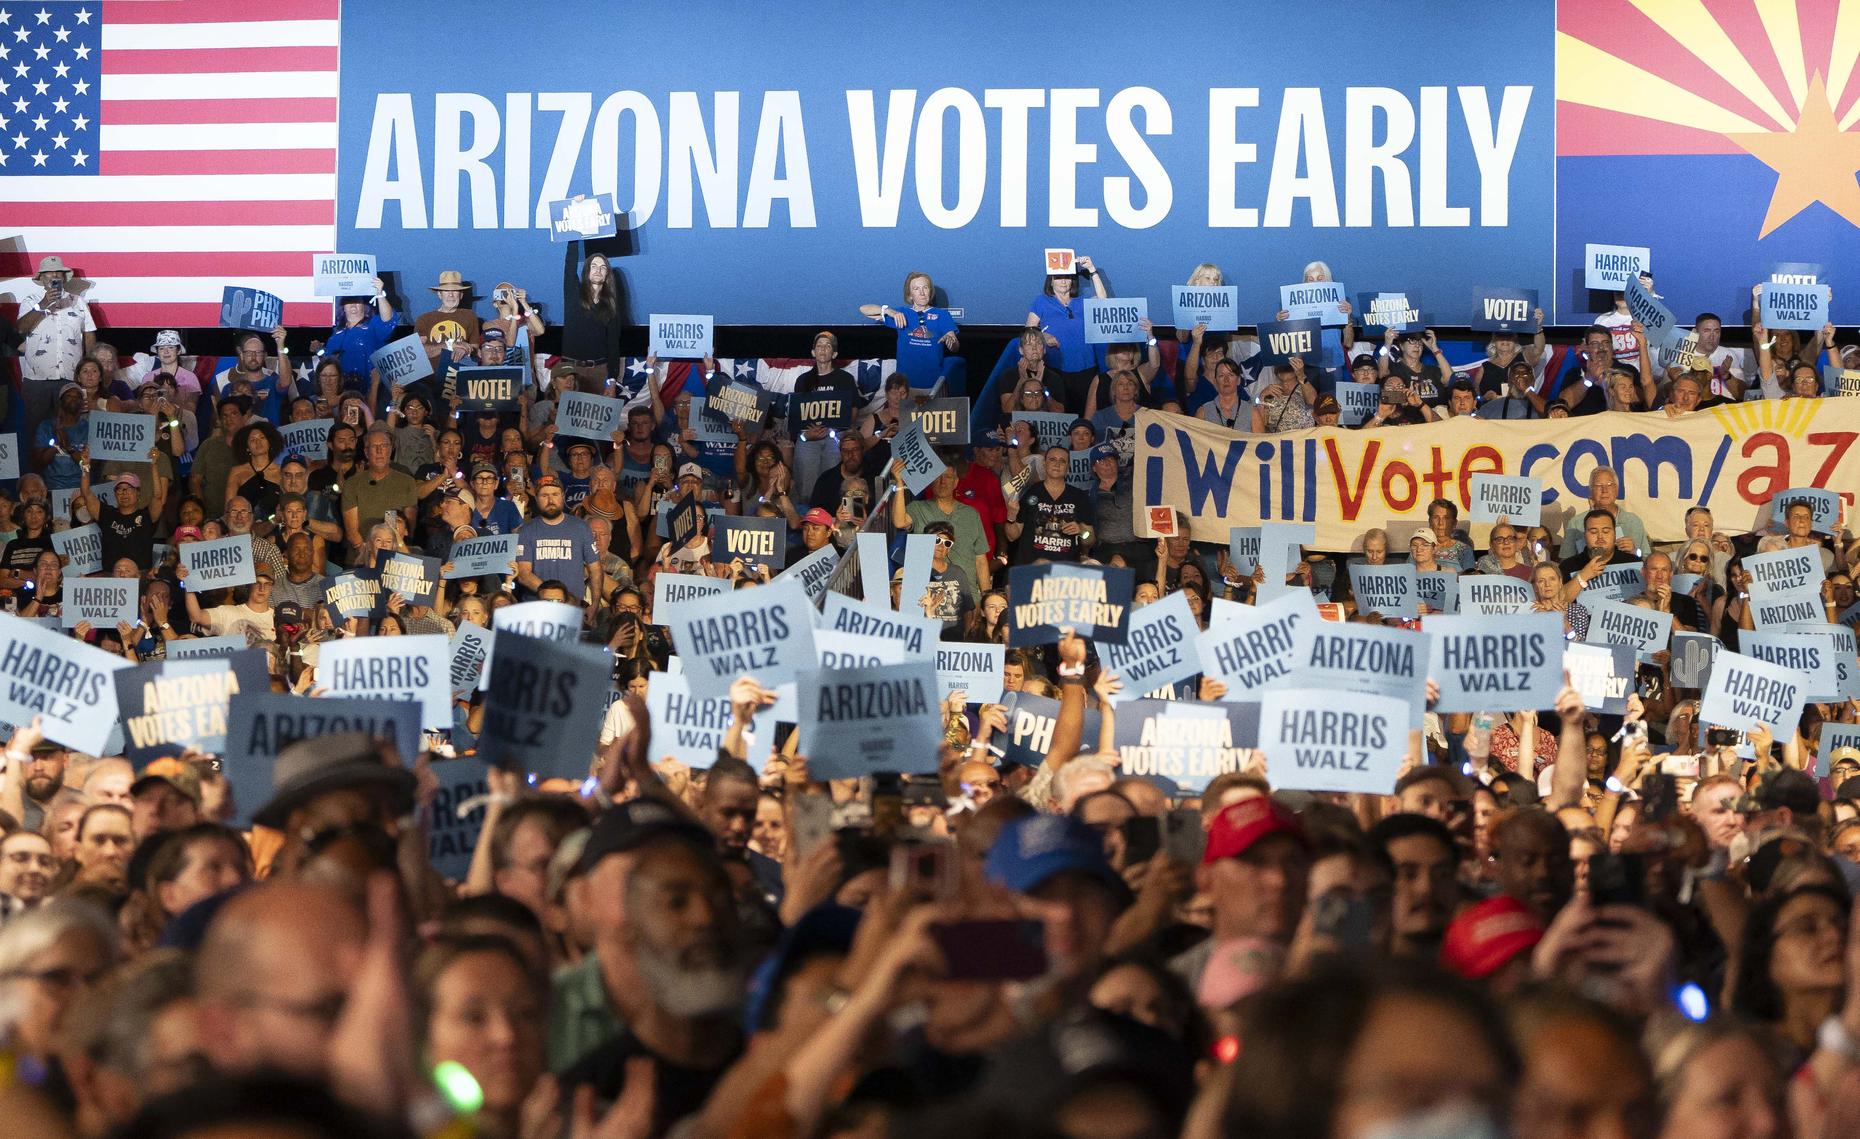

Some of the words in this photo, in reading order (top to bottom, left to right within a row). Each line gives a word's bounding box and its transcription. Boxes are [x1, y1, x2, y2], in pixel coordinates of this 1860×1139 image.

[355, 90, 817, 231] ARIZONA
[846, 86, 1174, 229] VOTES
[1208, 85, 1533, 228] EARLY
[321, 260, 370, 275] ARIZONA
[1595, 253, 1640, 272] HARRIS
[254, 293, 280, 312] PHX
[1179, 292, 1230, 308] ARIZONA
[1289, 288, 1339, 306] ARIZONA
[1370, 297, 1410, 312] ARIZONA
[1629, 285, 1666, 328] HARRIS
[1769, 292, 1818, 310] HARRIS
[251, 308, 279, 328] PHX
[1092, 306, 1138, 324] HARRIS
[1363, 311, 1390, 325] VOTES
[1392, 309, 1419, 324] EARLY
[1483, 298, 1527, 322] VOTE!
[1630, 304, 1654, 331] WALZ
[1776, 310, 1811, 320] WALZ
[658, 323, 704, 339] HARRIS
[1100, 324, 1132, 335] WALZ
[665, 340, 697, 350] WALZ
[1268, 330, 1312, 355] VOTE!
[1674, 338, 1698, 354] ARIZ
[377, 345, 417, 376] HARRIS
[1664, 348, 1693, 366] VOTES
[386, 363, 416, 383] WALZ
[1834, 376, 1860, 391] ARIZO
[468, 379, 511, 400] VOTE!
[718, 385, 758, 408] ARIZONA
[1345, 390, 1380, 408] HARR
[566, 400, 613, 423] HARRIS
[708, 395, 733, 416] VOTES
[735, 404, 764, 423] EARLY
[800, 400, 841, 421] VOTE!
[96, 421, 144, 441] HARRIS
[571, 417, 603, 432] WALZ
[704, 424, 733, 433] WAL
[1035, 420, 1070, 436] ARRIS
[102, 441, 136, 452] WALZ
[904, 427, 933, 475] HARRIS
[897, 442, 916, 475] WALZ
[1480, 483, 1532, 505] HARRIS
[1780, 495, 1830, 514] HRIS
[1488, 502, 1523, 516] WALZ
[673, 505, 693, 542] VOTE!
[63, 533, 102, 556] HARR
[455, 540, 508, 558] ARIZONA
[727, 528, 775, 556] VOTE!
[1034, 535, 1072, 547] HARRIS
[74, 552, 102, 566] WAL
[191, 546, 242, 570] HARRIS
[536, 547, 572, 560] KAMALA
[200, 566, 236, 580] WALZ
[384, 560, 425, 580] ARIZONA
[800, 556, 834, 587] RRIS
[1755, 557, 1811, 582] HARRIS
[355, 579, 381, 594] VOTES
[401, 580, 433, 595] EARLY
[1031, 576, 1107, 603] ARIZONA
[1359, 575, 1407, 595] HARRIS
[1416, 578, 1445, 592] RRIS
[1471, 585, 1528, 604] HARRIS
[1767, 576, 1807, 592] WALZ
[73, 588, 127, 606] HARRIS
[335, 594, 376, 614] ARIZONA
[1367, 597, 1401, 607] WALZ
[1416, 591, 1438, 600] ALZ
[81, 607, 118, 618] WALZ
[1014, 602, 1065, 629] VOTES
[1069, 601, 1124, 628] EARLY
[1480, 605, 1519, 615] WALZ
[1760, 602, 1817, 625] ARIZONA
[688, 604, 790, 656] HARRIS
[835, 607, 923, 653] ARIZONA
[1600, 610, 1658, 640] HARRIS
[1108, 614, 1183, 670] HARRIS
[1444, 633, 1545, 670] HARRIS
[451, 634, 482, 686] HARRIS
[709, 647, 780, 677] WALZ
[937, 650, 994, 672] RIZONA
[1125, 648, 1182, 682] WALZ
[1310, 634, 1414, 678] ARIZONA
[1752, 644, 1820, 669] HARRIS
[1, 640, 106, 706] HARRIS
[333, 656, 429, 691] HARRIS
[1240, 655, 1293, 689] WAL
[1460, 672, 1531, 693] WALZ
[144, 670, 240, 714] ARIZONA
[1724, 668, 1797, 710] HARRIS
[9, 682, 77, 723] WALZ
[818, 678, 928, 722] ARIZONA
[665, 693, 755, 733] HARR
[1733, 699, 1782, 725] WALZ
[128, 708, 190, 749] VOTES
[1014, 710, 1057, 755] PH
[1140, 716, 1233, 748] ARIZONA
[1279, 710, 1388, 750] HARRIS
[678, 729, 722, 750] WAL
[1120, 745, 1185, 776] VOTES
[1293, 748, 1369, 771] WALZ
